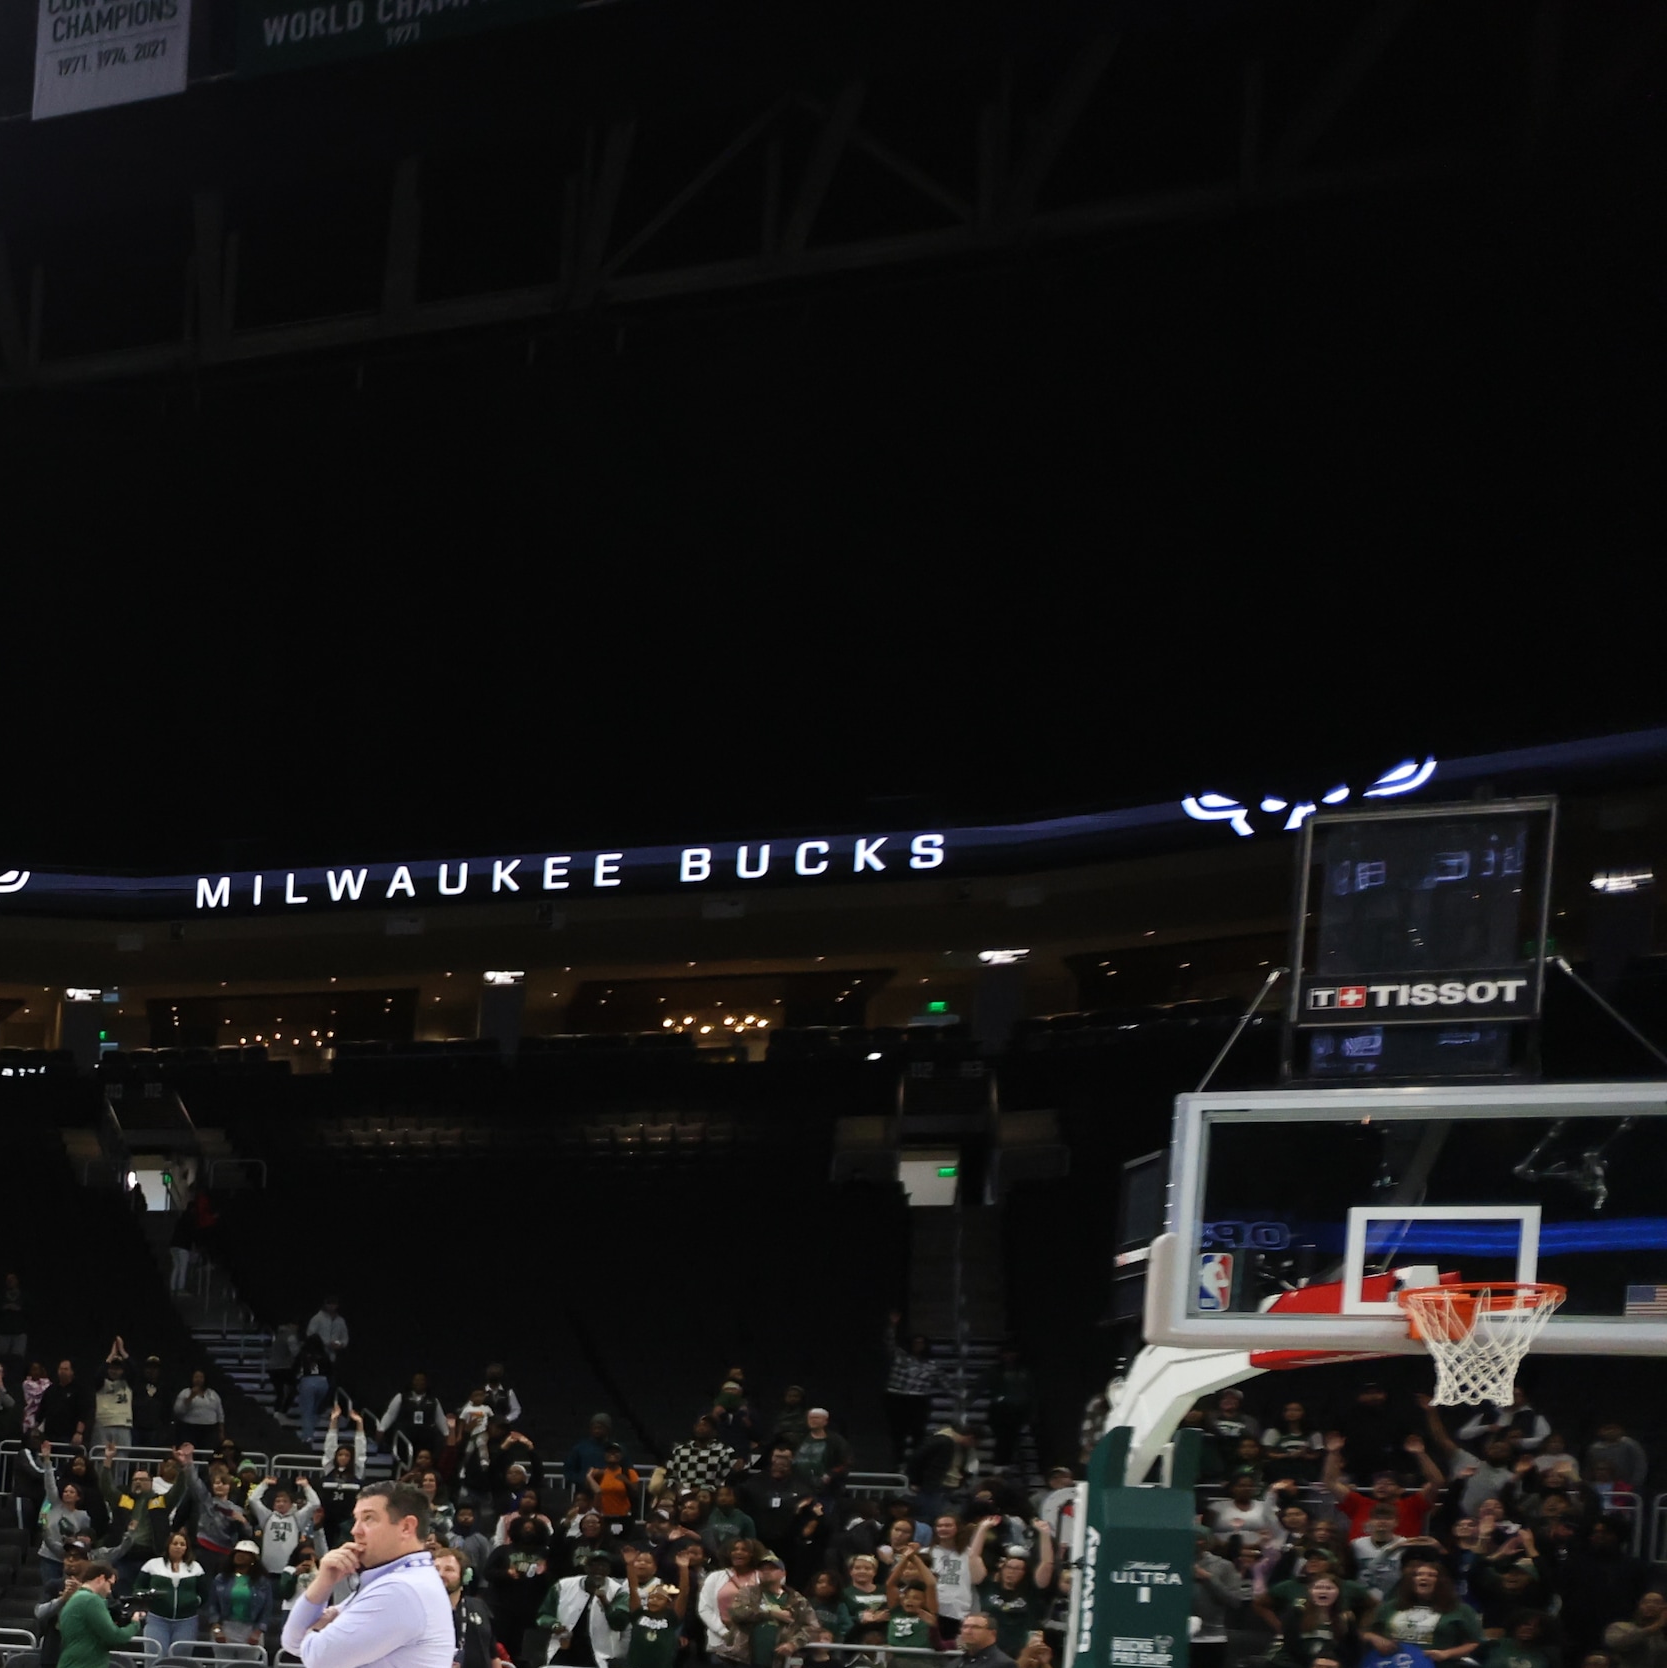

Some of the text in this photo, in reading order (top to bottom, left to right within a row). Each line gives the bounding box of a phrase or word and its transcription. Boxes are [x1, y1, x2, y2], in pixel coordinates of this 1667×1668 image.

[51, 3, 178, 43] CHAMPIONS
[263, 3, 363, 47] WORLD
[134, 38, 166, 62] 2021
[195, 833, 946, 909] MILWAUKEE BUCKS
[1371, 979, 1528, 1008] TISSOT
[274, 1531, 287, 1542] 34
[1110, 1571, 1184, 1586] ULTRA
